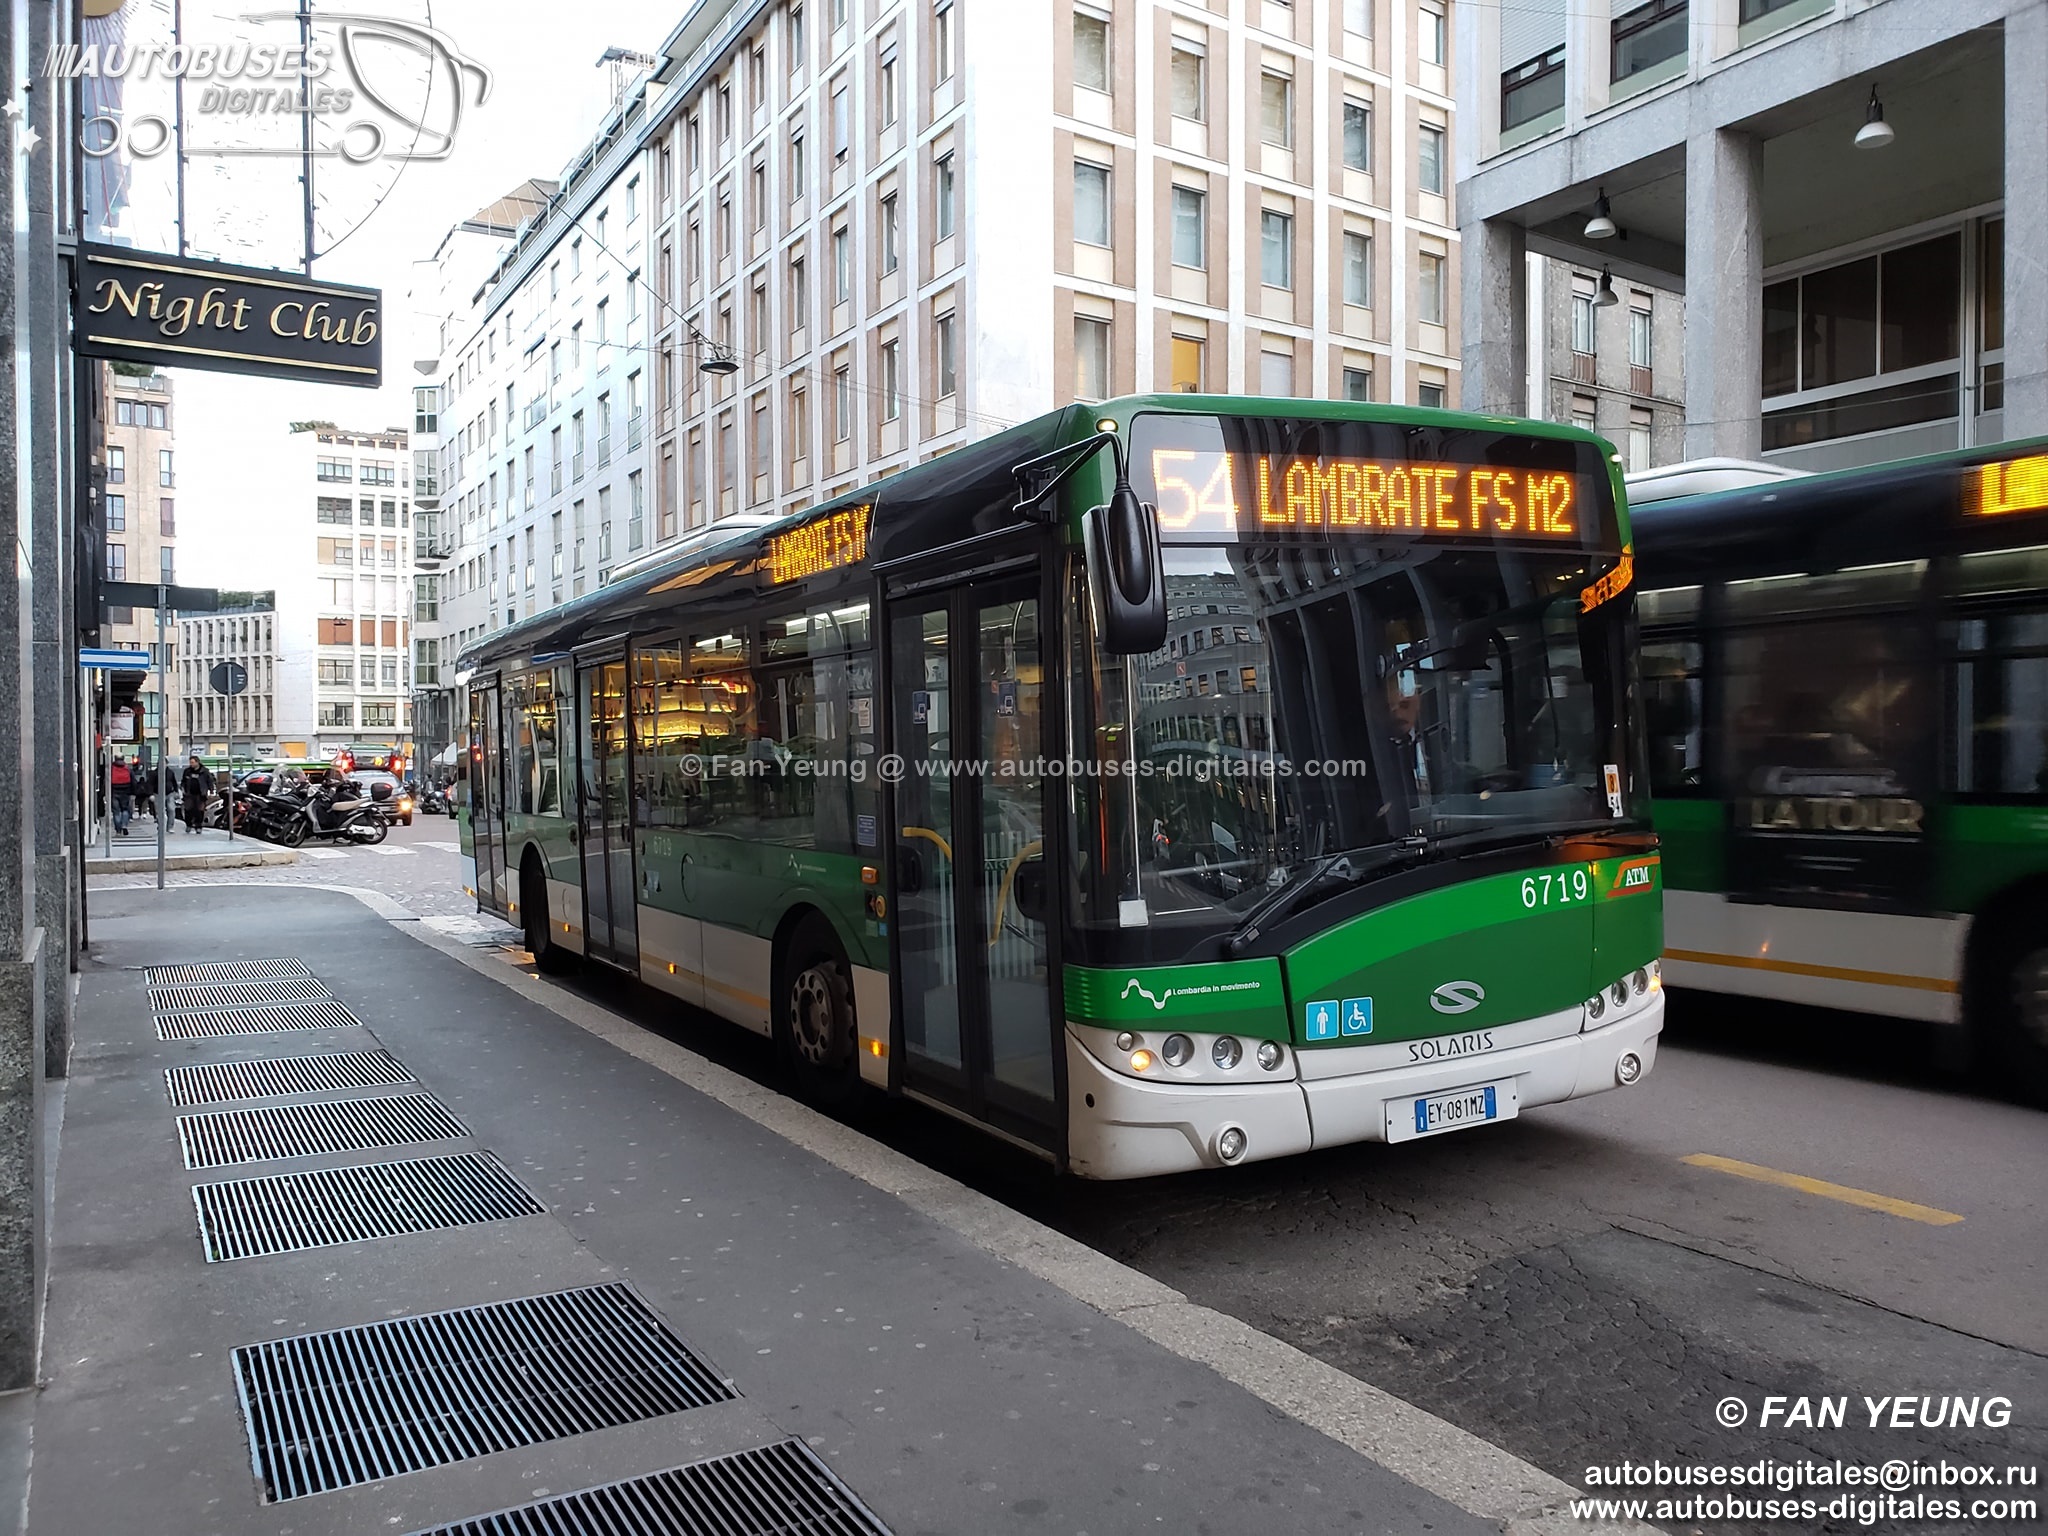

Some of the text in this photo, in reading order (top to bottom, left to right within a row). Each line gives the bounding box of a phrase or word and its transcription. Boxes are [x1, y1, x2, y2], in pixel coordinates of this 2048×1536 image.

[88, 278, 378, 346] Night Club
[1152, 449, 1573, 533] 54 LAMBRATE FS M2
[853, 503, 871, 560] M
[1521, 869, 1588, 908] 6719
[1625, 866, 1650, 887] ATM
[1172, 986, 1212, 996] Lombardia
[1221, 982, 1260, 992] movimento
[1408, 1031, 1494, 1062] SOLARIS
